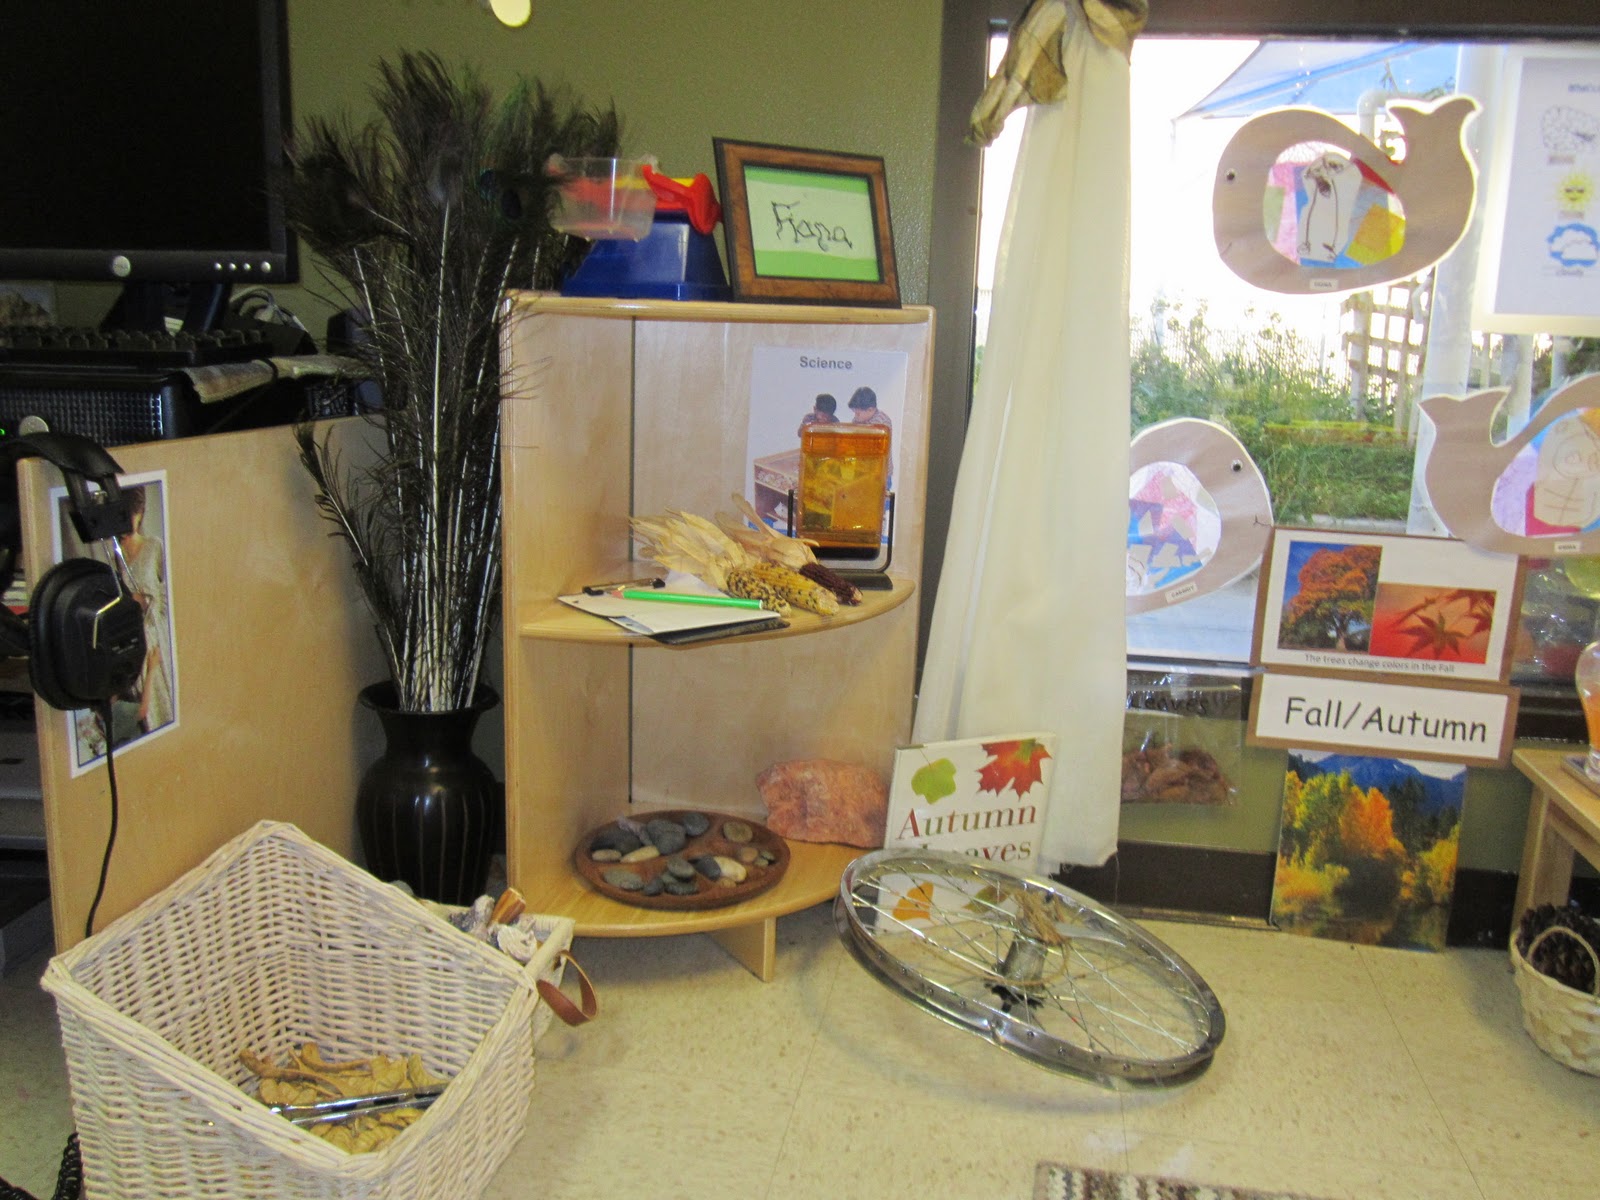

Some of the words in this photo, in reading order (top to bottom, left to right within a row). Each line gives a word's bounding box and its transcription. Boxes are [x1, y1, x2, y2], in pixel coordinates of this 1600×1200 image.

[799, 355, 853, 369] Science
[1305, 653, 1321, 663] The
[1323, 655, 1345, 664] trees
[1348, 657, 1380, 668] change
[1382, 660, 1409, 670] colors
[1411, 662, 1420, 671] in
[1421, 663, 1437, 672] the
[1438, 663, 1456, 673] Fall
[1285, 696, 1487, 743] Fall/Autumn
[896, 805, 1037, 840] Autumn
